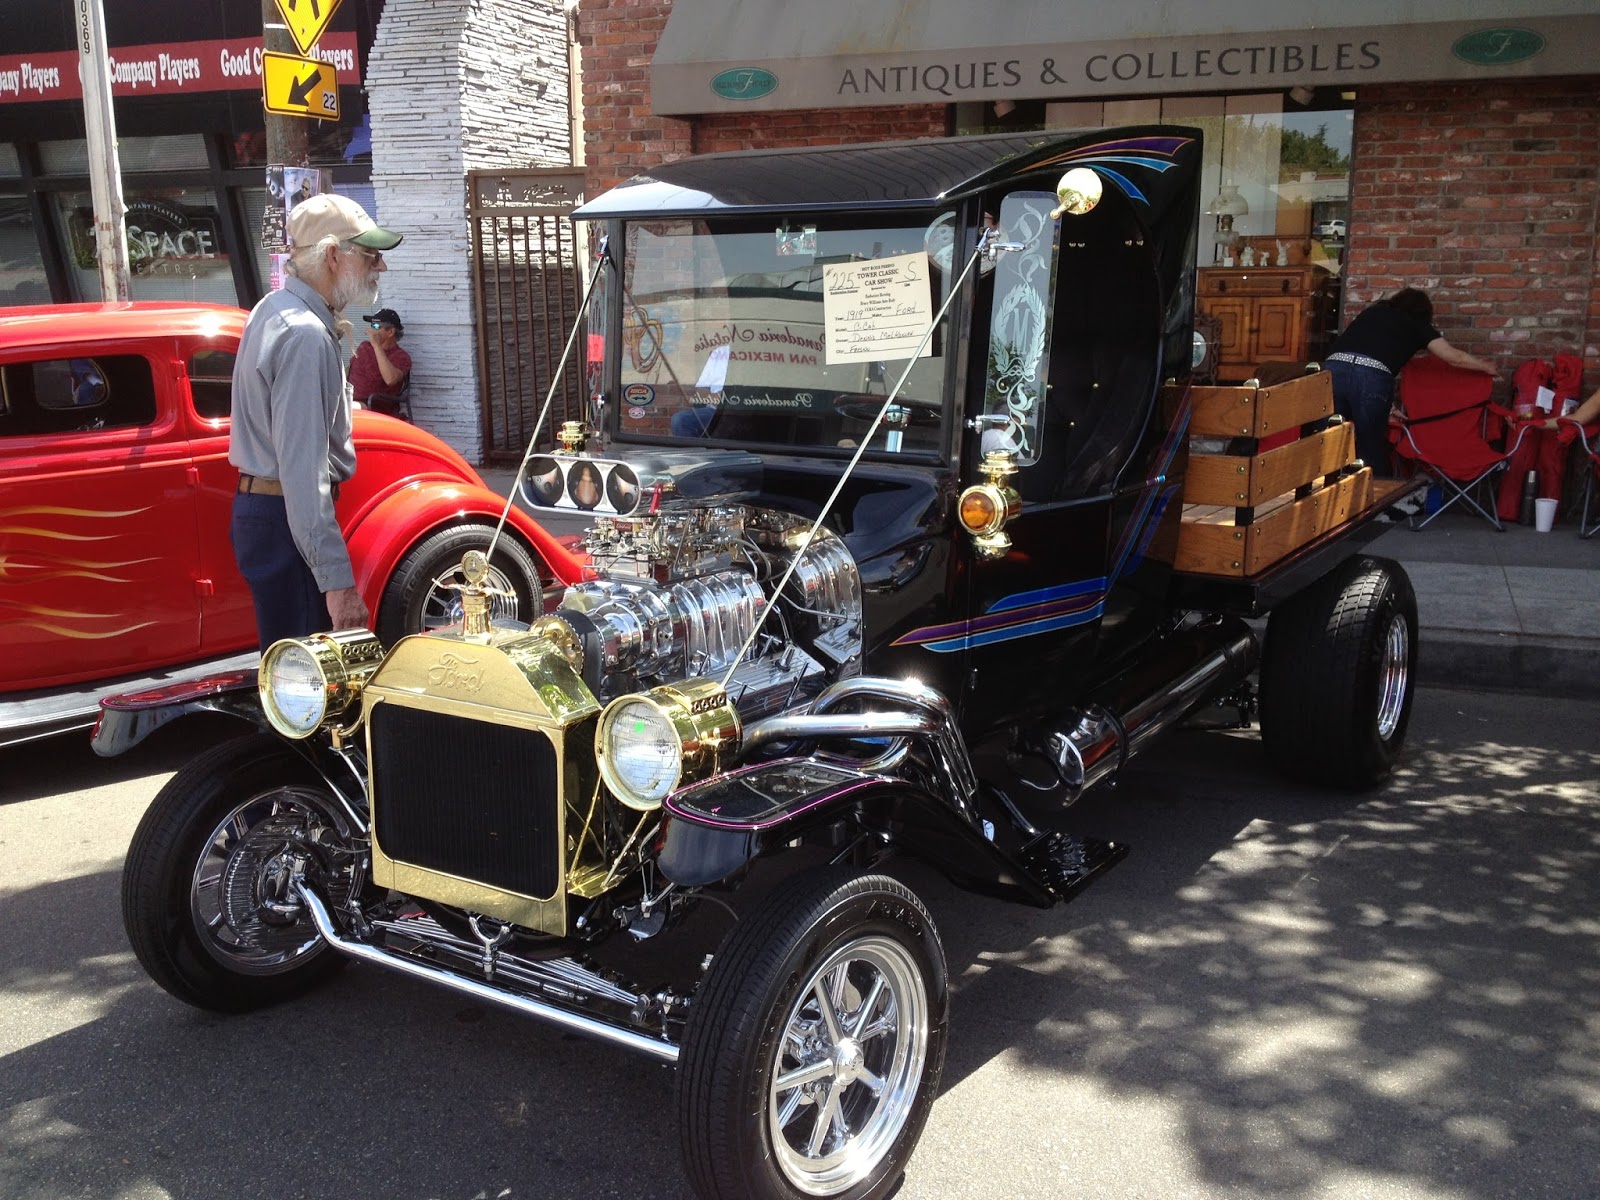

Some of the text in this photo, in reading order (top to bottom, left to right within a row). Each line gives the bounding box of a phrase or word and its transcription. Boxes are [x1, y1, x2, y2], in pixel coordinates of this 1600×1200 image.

[108, 56, 157, 88] Company
[158, 53, 200, 86] Players
[220, 48, 251, 77] Good
[838, 41, 1381, 96] ANTIQUES & COLLECTIBLES
[21, 63, 60, 94] Players
[323, 93, 336, 110] 22
[127, 225, 214, 259] SPACE
[136, 263, 196, 275] EATRE
[857, 268, 899, 280] TOWER CLASSIC
[428, 652, 485, 693] Ford
